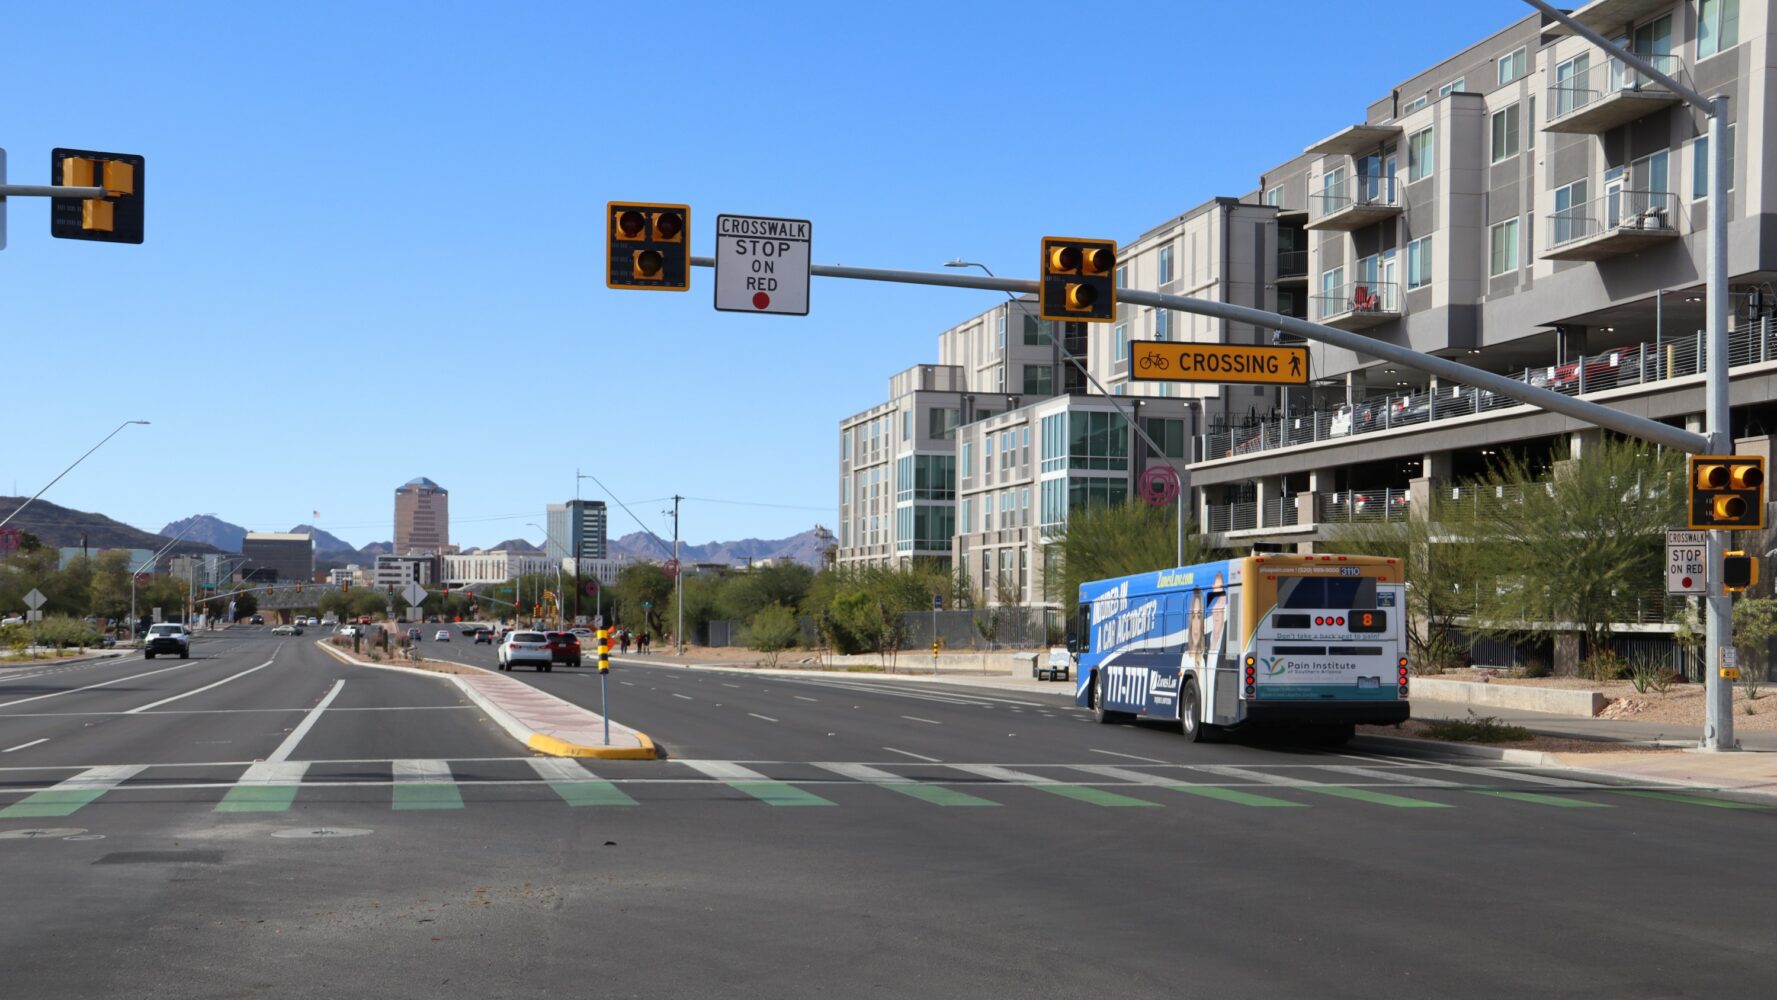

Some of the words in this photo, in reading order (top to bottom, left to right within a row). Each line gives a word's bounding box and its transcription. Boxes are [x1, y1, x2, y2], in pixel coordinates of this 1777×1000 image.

[722, 218, 806, 238] CROSSWALK
[735, 239, 791, 258] STOP
[751, 259, 774, 274] ON
[746, 277, 778, 292] RED
[1179, 352, 1279, 374] CROSSING
[1669, 532, 1705, 544] CROSSWALK
[1672, 549, 1702, 562] STOP
[1341, 567, 1360, 575] 3110
[1670, 564, 1683, 574] ON
[1686, 564, 1704, 574] RED
[1119, 581, 1129, 612] IN
[1116, 599, 1157, 645] ACCIDENT?
[1362, 613, 1373, 626] 8
[1287, 661, 1310, 670] Pain
[1312, 661, 1356, 670] Institute
[1107, 665, 1149, 706] 777-7777
